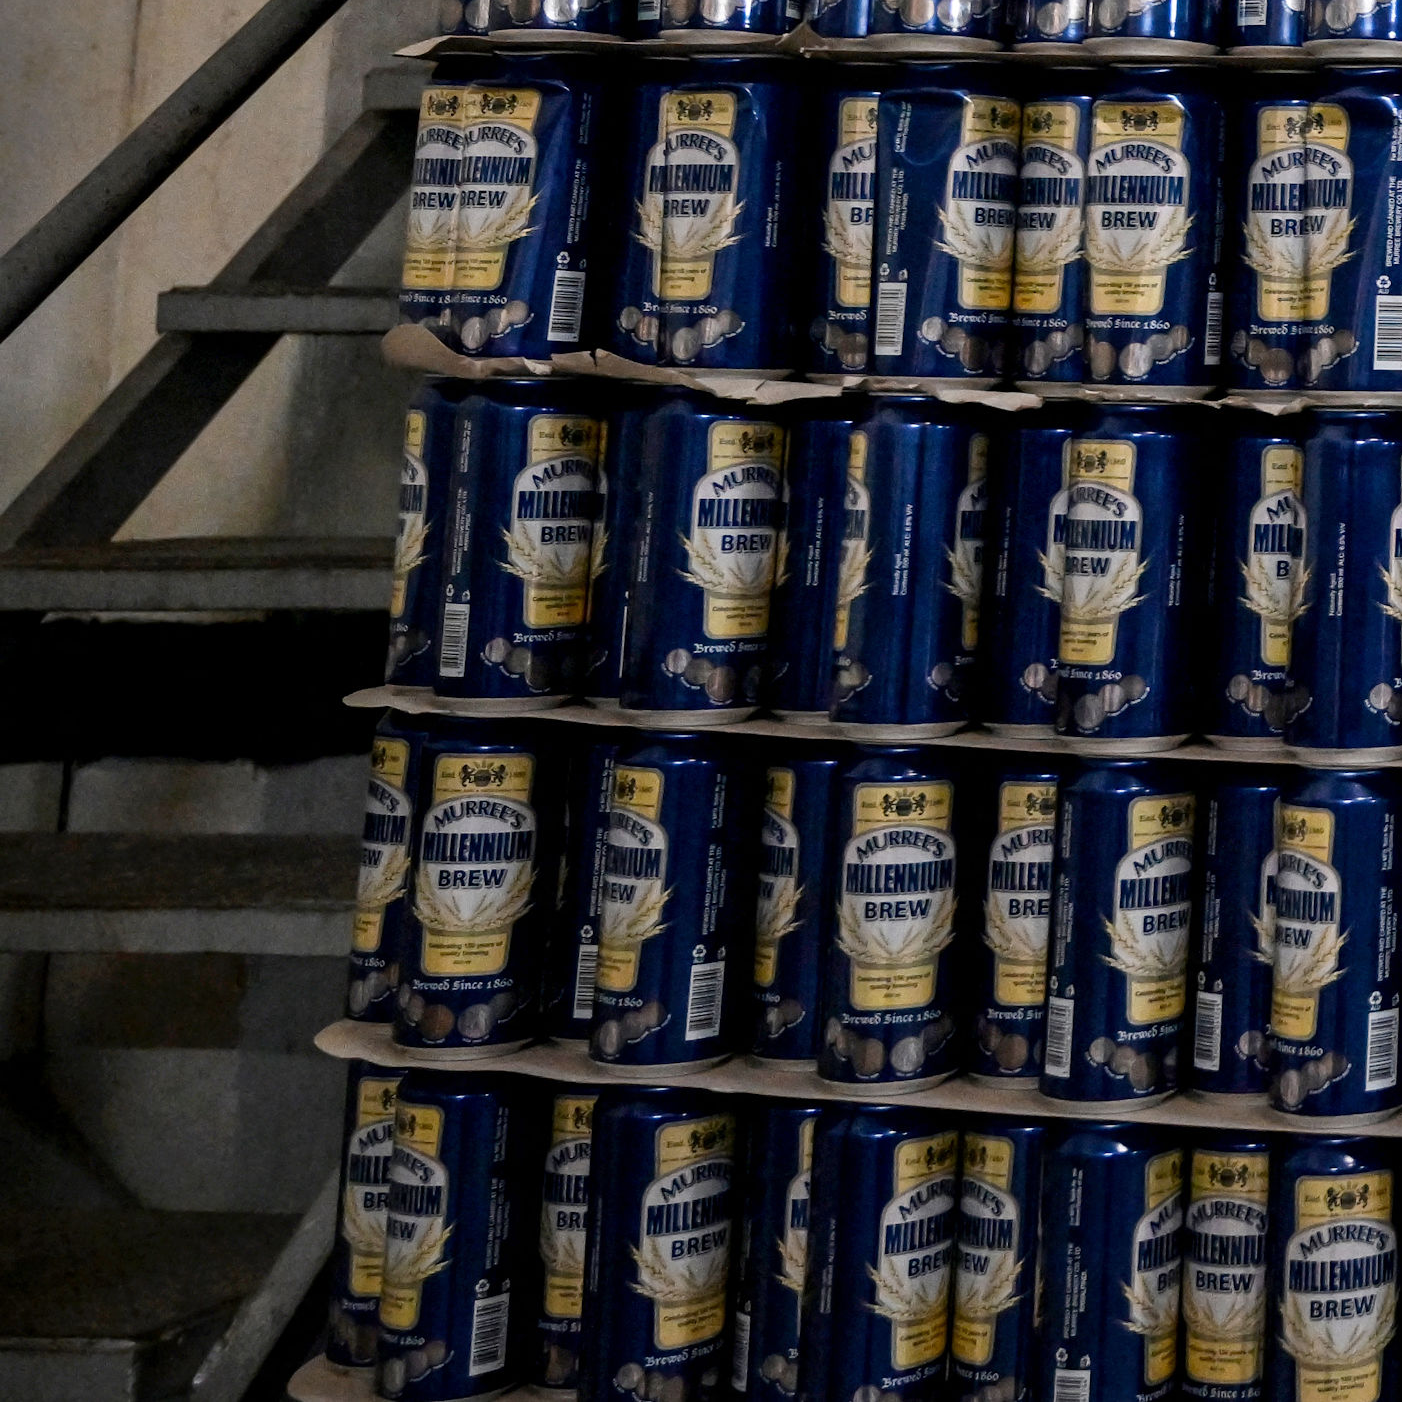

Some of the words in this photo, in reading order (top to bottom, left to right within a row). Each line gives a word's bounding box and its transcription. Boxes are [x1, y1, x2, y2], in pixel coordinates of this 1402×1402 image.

[1095, 144, 1176, 174] MURREE'S
[1101, 211, 1158, 229] BREW
[1115, 318, 1142, 330] Since
[1144, 319, 1170, 330] 1860
[434, 800, 526, 832] MURREE'S
[423, 831, 531, 863] MILLENNIUM
[856, 829, 946, 861] MURREE'S
[438, 868, 507, 889] BREW
[846, 860, 953, 894] MILLENNIUM
[864, 899, 931, 921] BREW
[413, 978, 449, 991] Brewed
[452, 978, 481, 990] Since
[484, 977, 513, 989] 1860
[841, 1012, 879, 1026] Brewed
[882, 1012, 911, 1025] Since
[914, 1009, 942, 1022] 1860
[1300, 1223, 1389, 1258] MURREE'S
[1289, 1249, 1394, 1293] MILLENNIUM
[1310, 1295, 1376, 1319] BREW
